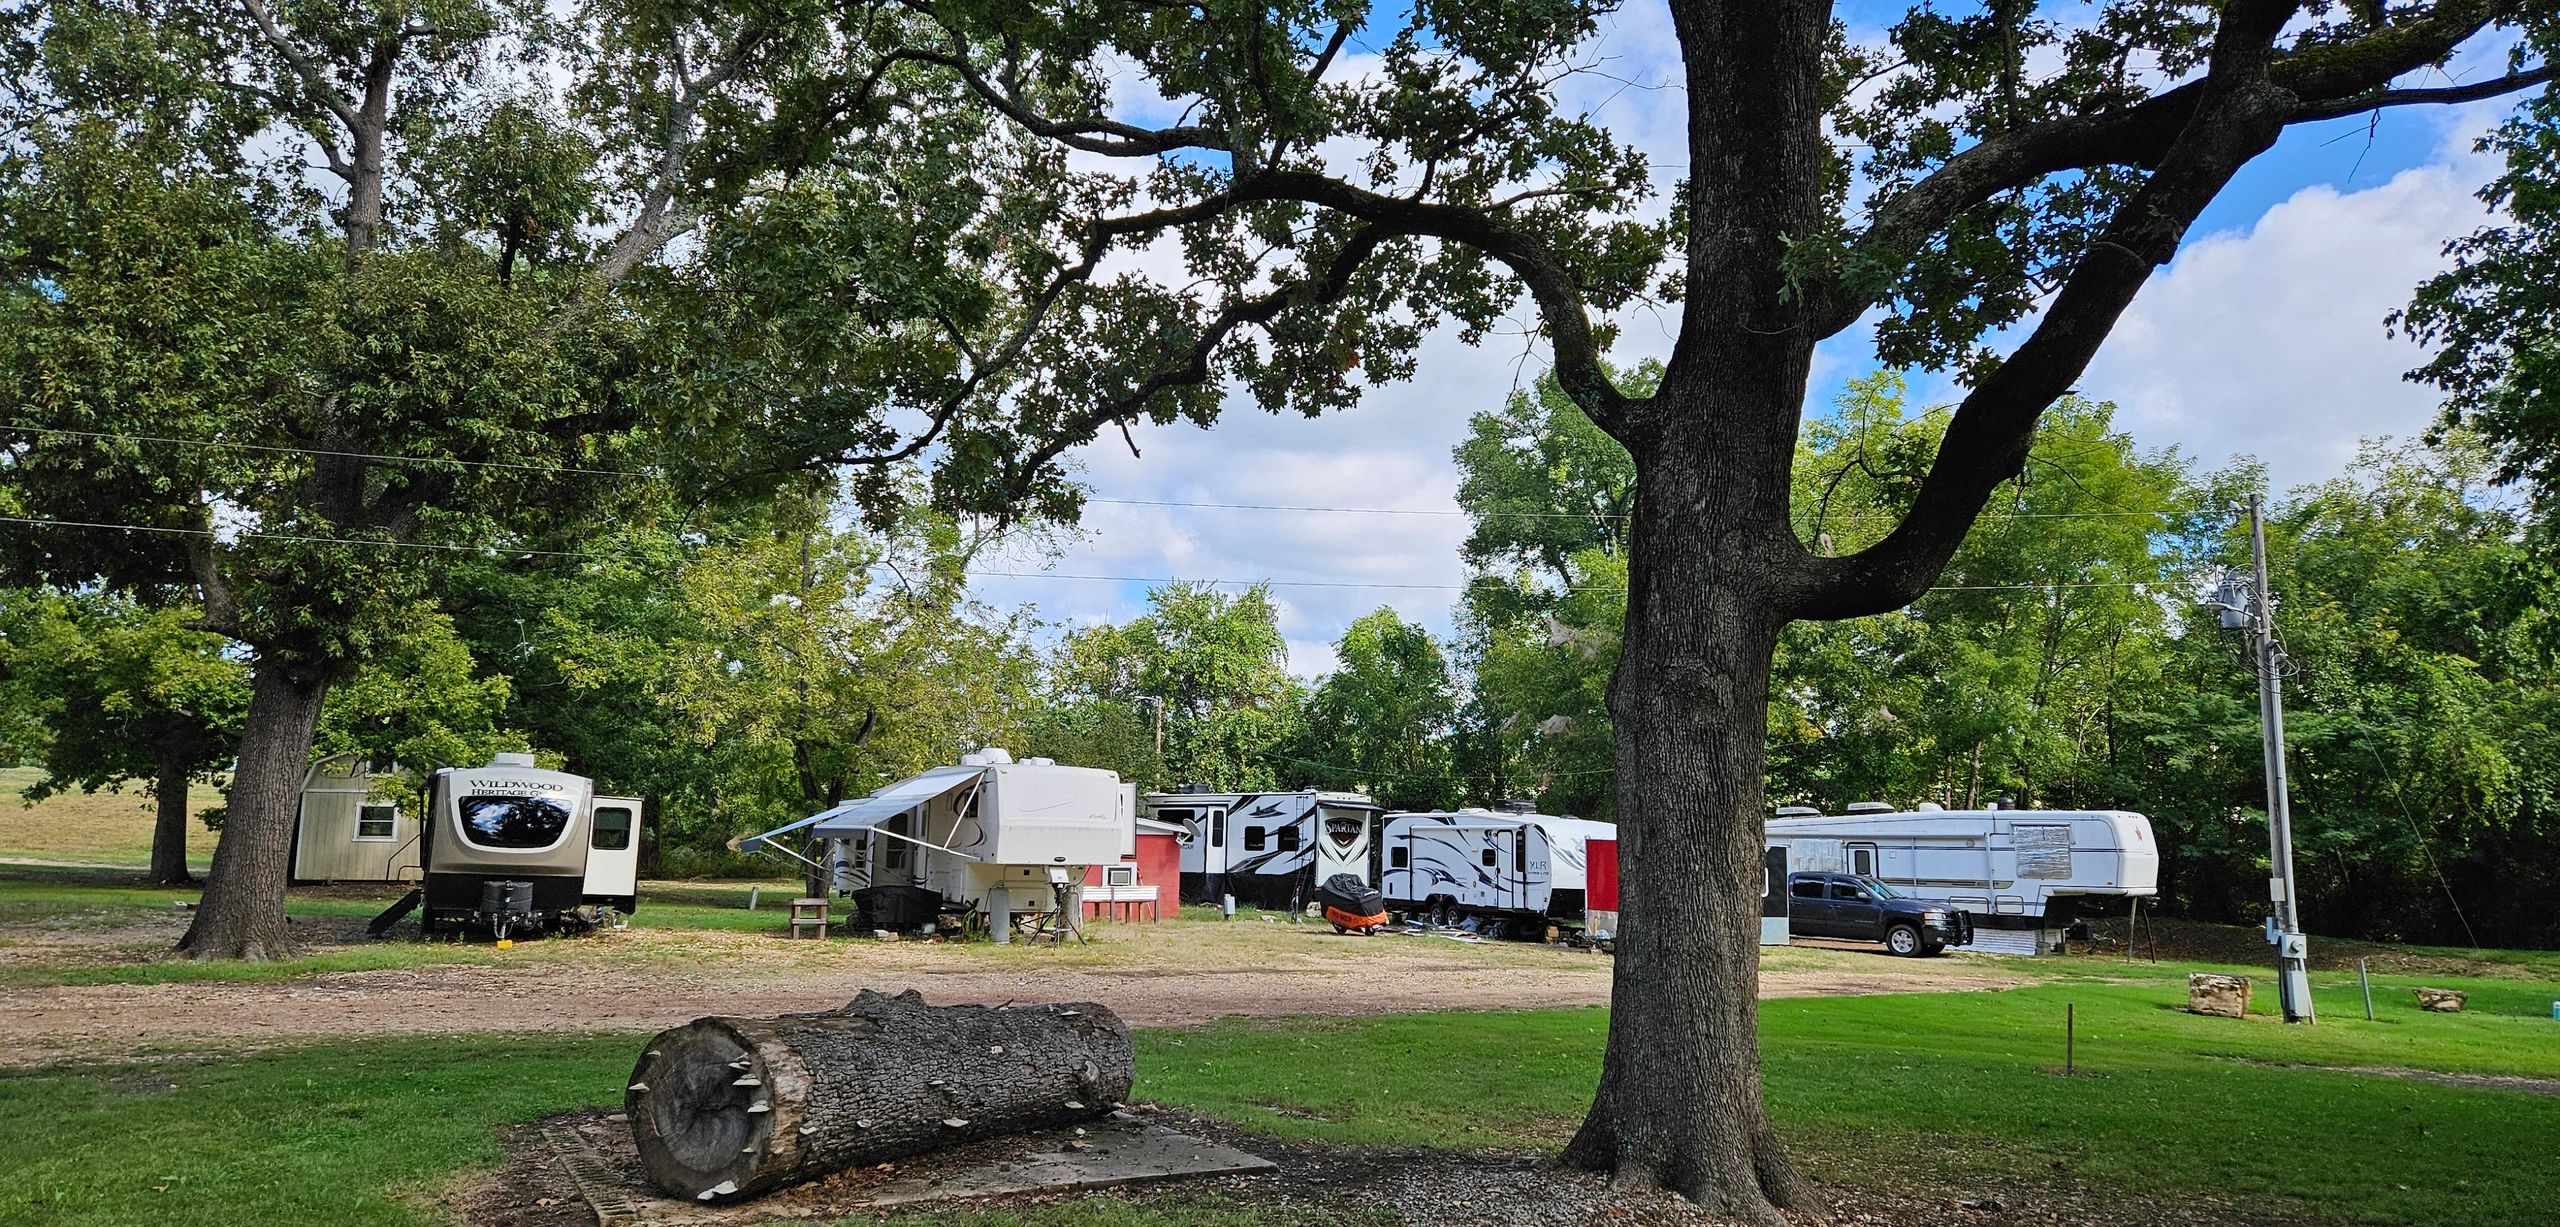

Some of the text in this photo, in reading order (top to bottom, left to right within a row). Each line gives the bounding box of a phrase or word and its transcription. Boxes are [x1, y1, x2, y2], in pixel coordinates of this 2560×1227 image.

[470, 780, 563, 791] WILDWOOD
[1325, 822, 1362, 835] SPARTAN
[1529, 861, 1547, 870] XLR
